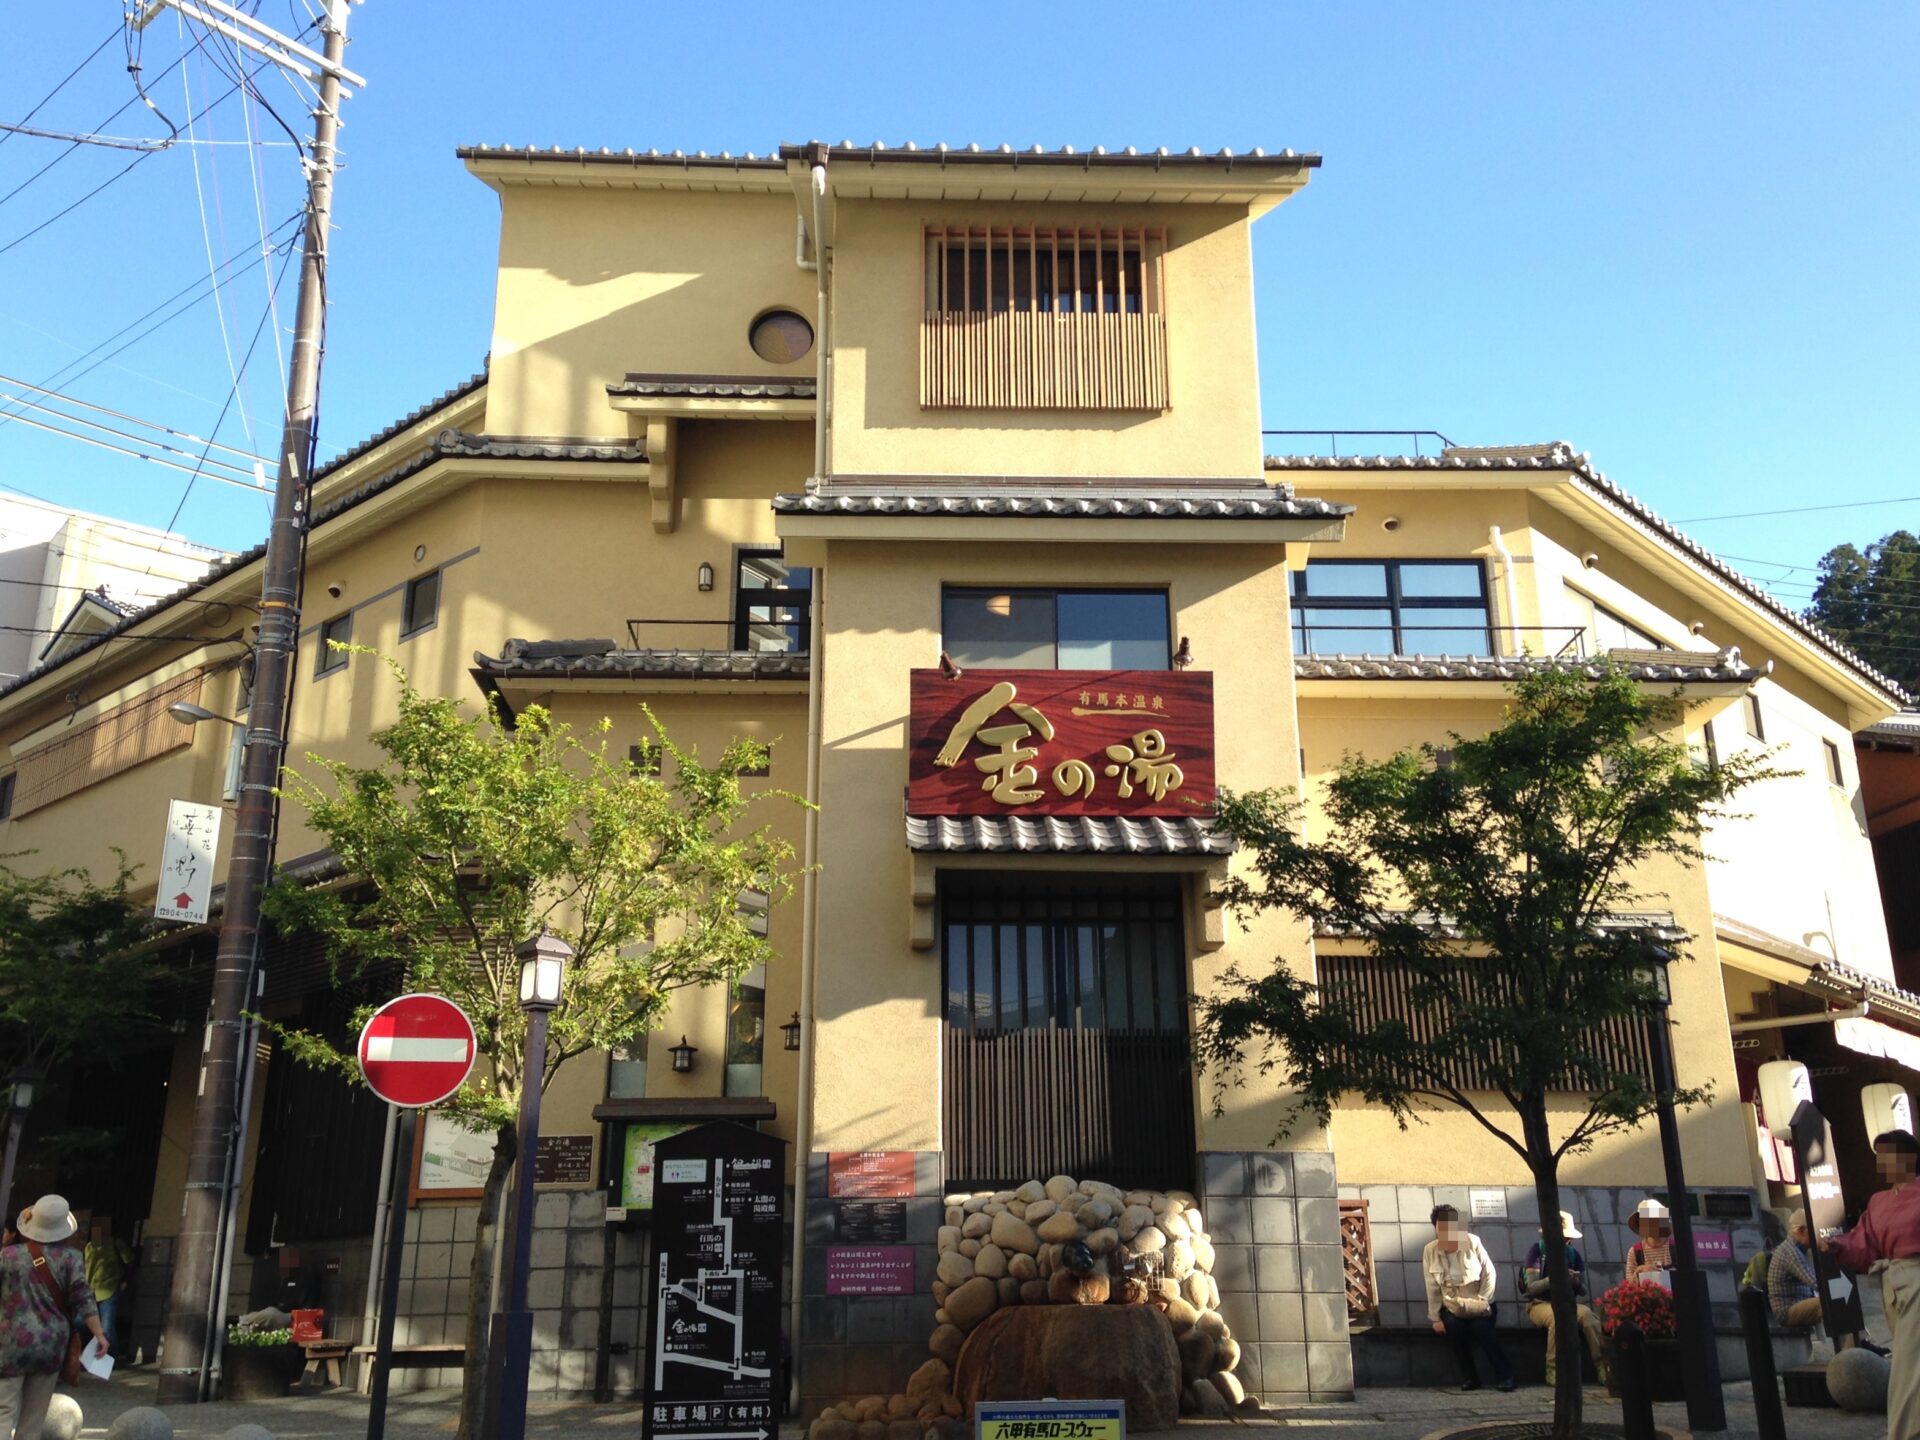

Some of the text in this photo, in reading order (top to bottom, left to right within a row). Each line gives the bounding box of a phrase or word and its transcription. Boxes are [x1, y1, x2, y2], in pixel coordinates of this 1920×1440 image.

[1078, 690, 1166, 710] 有馬本温泉
[933, 681, 1184, 805] 金の湯
[165, 908, 204, 920] 904-0744
[672, 1318, 698, 1334] 金の湯
[652, 1405, 707, 1422] 駐車場
[712, 1408, 721, 1418] P
[994, 1420, 1107, 1439] 六甲有馬ロープウェー
